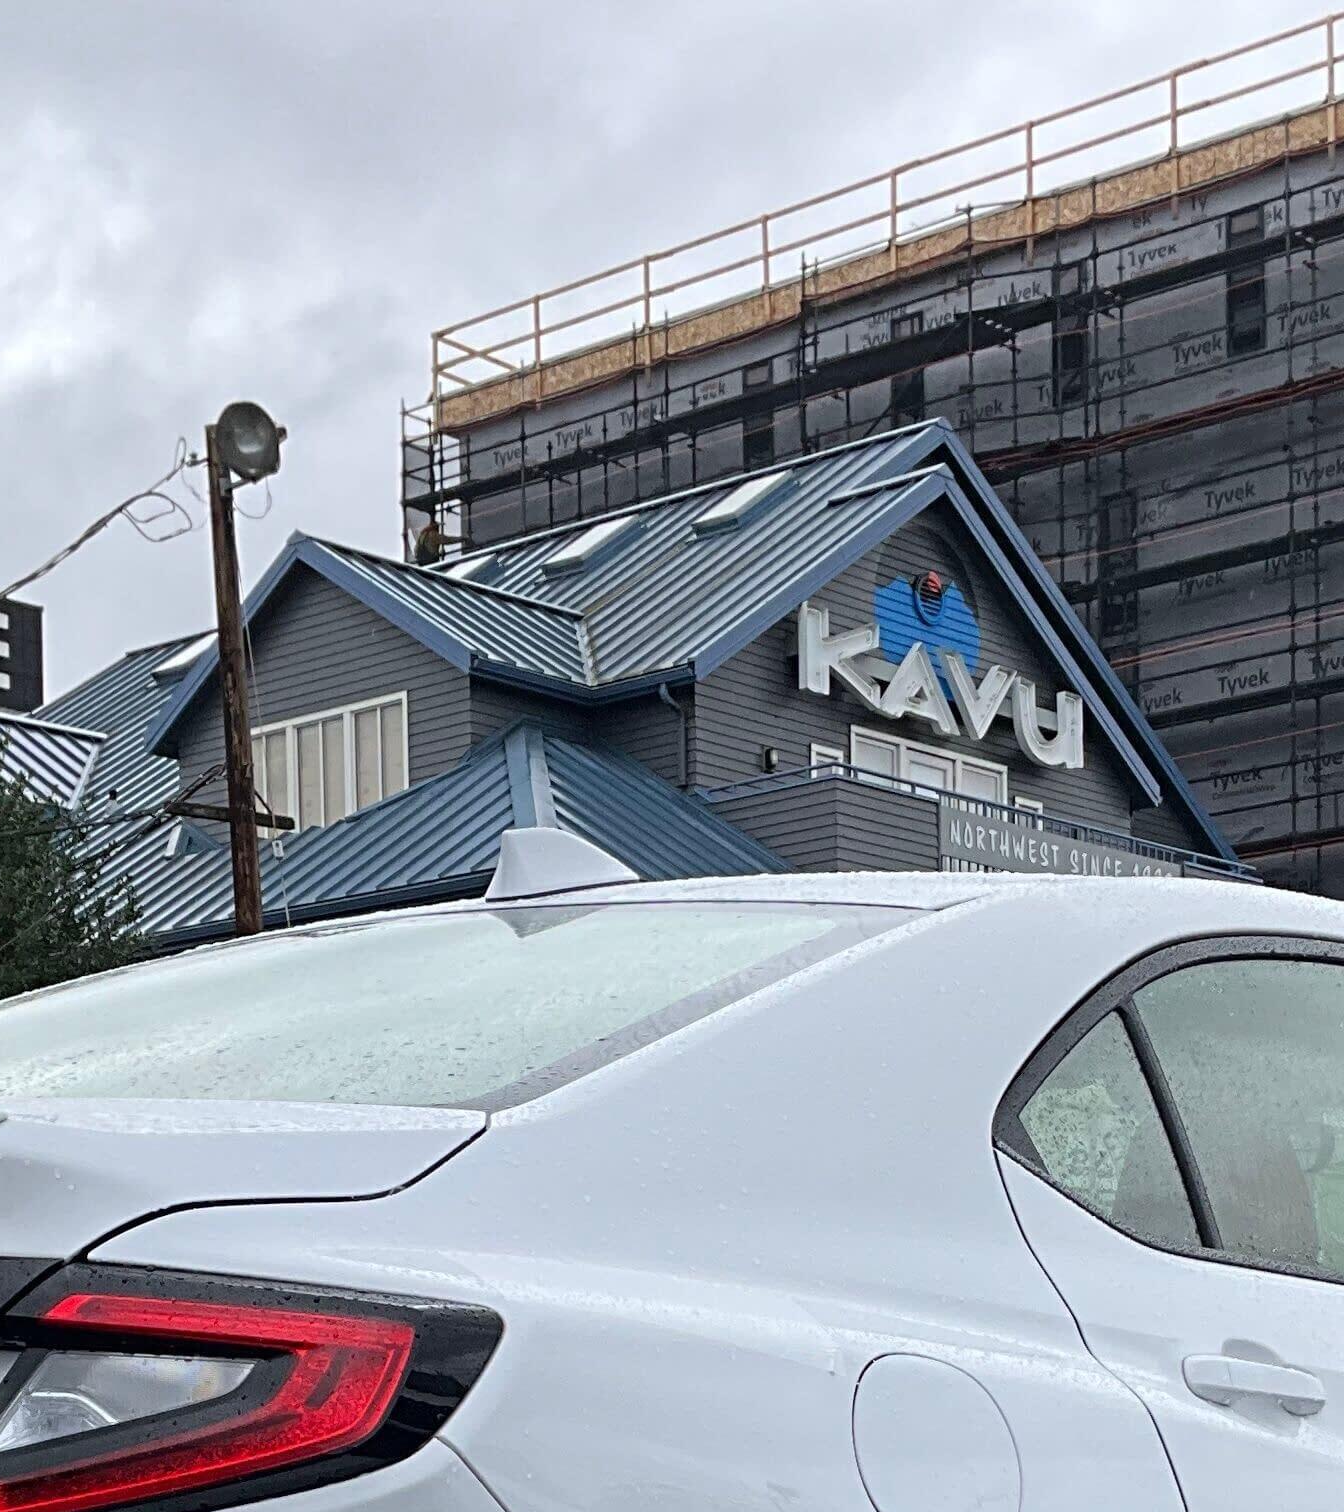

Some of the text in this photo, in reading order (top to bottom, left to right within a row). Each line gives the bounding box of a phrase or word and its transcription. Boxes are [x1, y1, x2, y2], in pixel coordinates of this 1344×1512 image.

[1127, 243, 1176, 267] Tyvek
[1172, 334, 1222, 364] Tyvek
[556, 424, 592, 448] Tyvek
[1205, 480, 1255, 509] Tyvek
[797, 601, 1084, 769] KAVU
[1217, 668, 1269, 697] Tyvek
[950, 819, 1059, 868] NORTHWEST
[1069, 849, 1122, 877] SINCE
